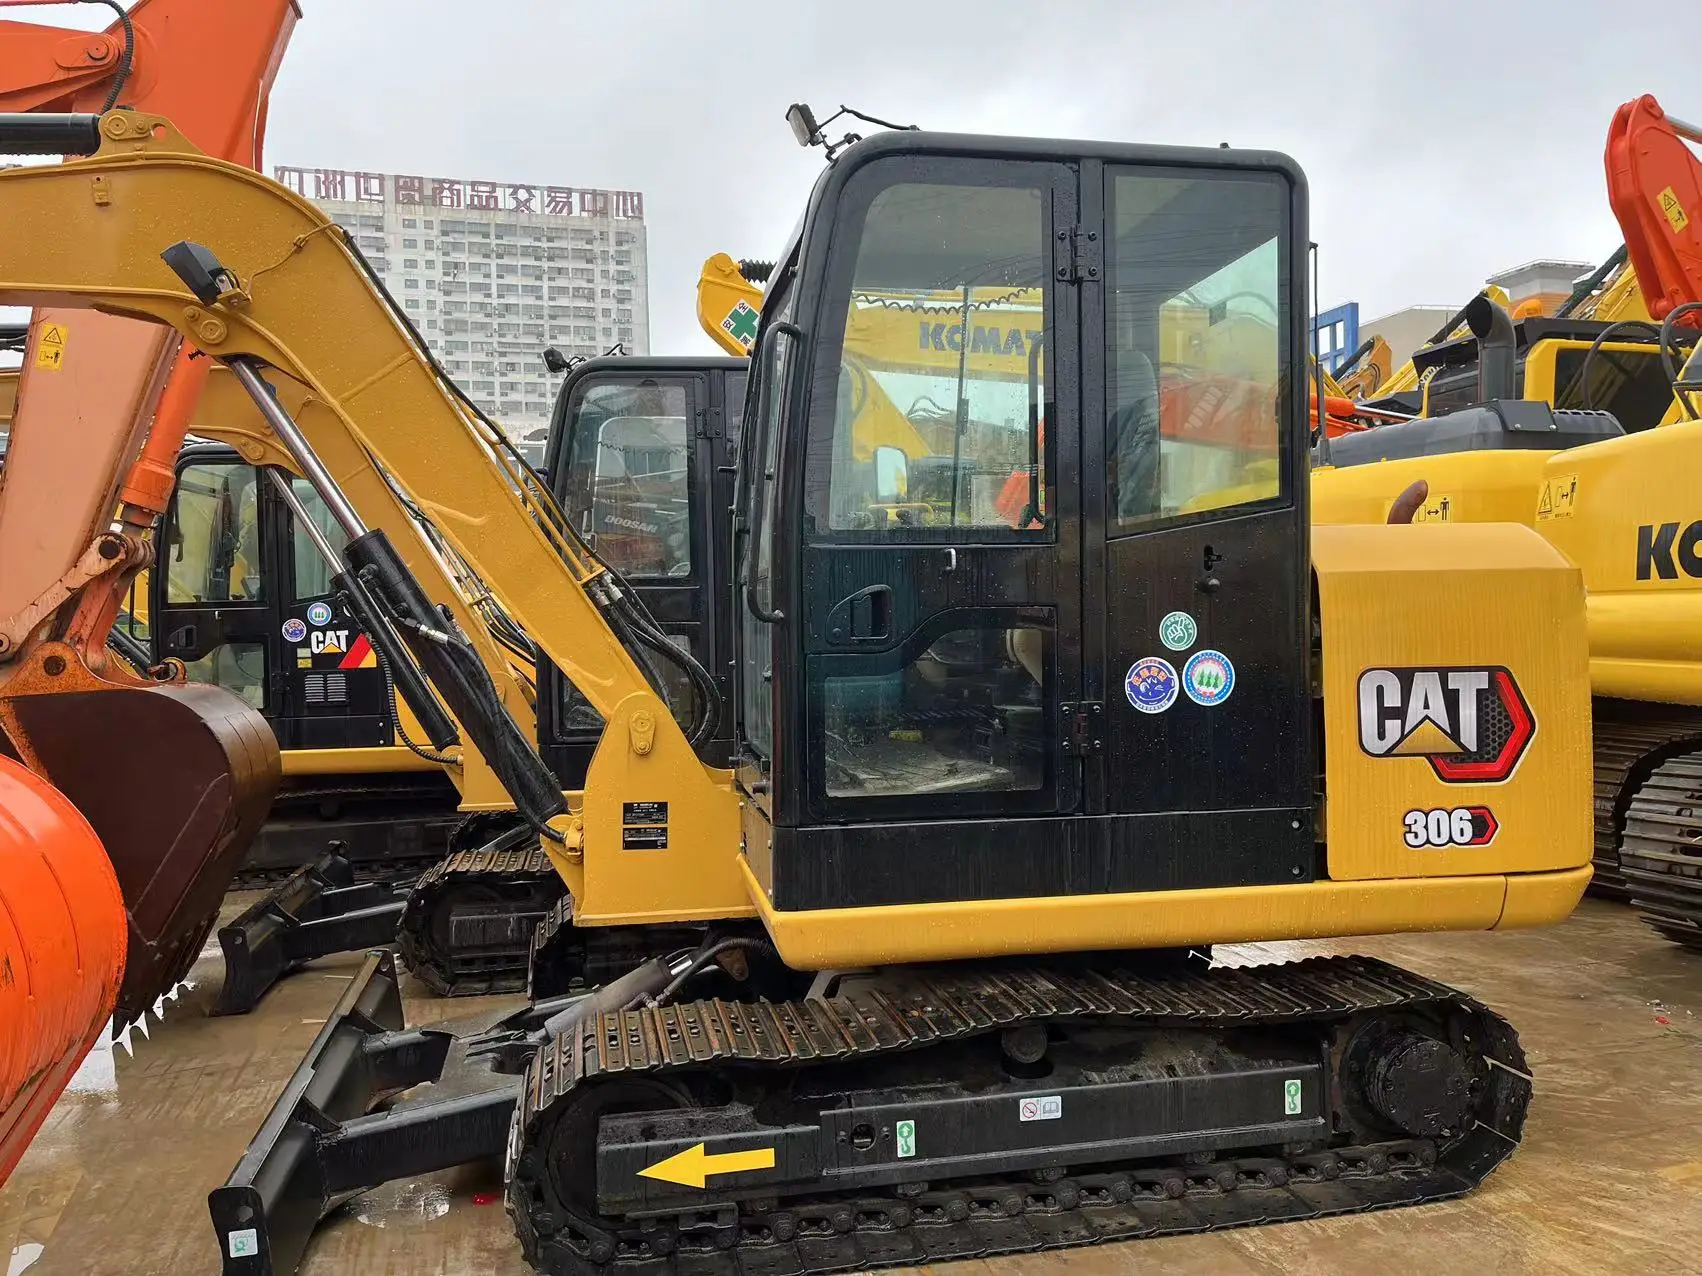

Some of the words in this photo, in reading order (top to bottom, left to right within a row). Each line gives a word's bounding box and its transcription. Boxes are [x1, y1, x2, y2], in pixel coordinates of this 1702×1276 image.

[604, 514, 658, 533] DOOSAN
[310, 630, 349, 654] CAT
[1359, 669, 1489, 756] CAT
[1403, 807, 1474, 847] 306
